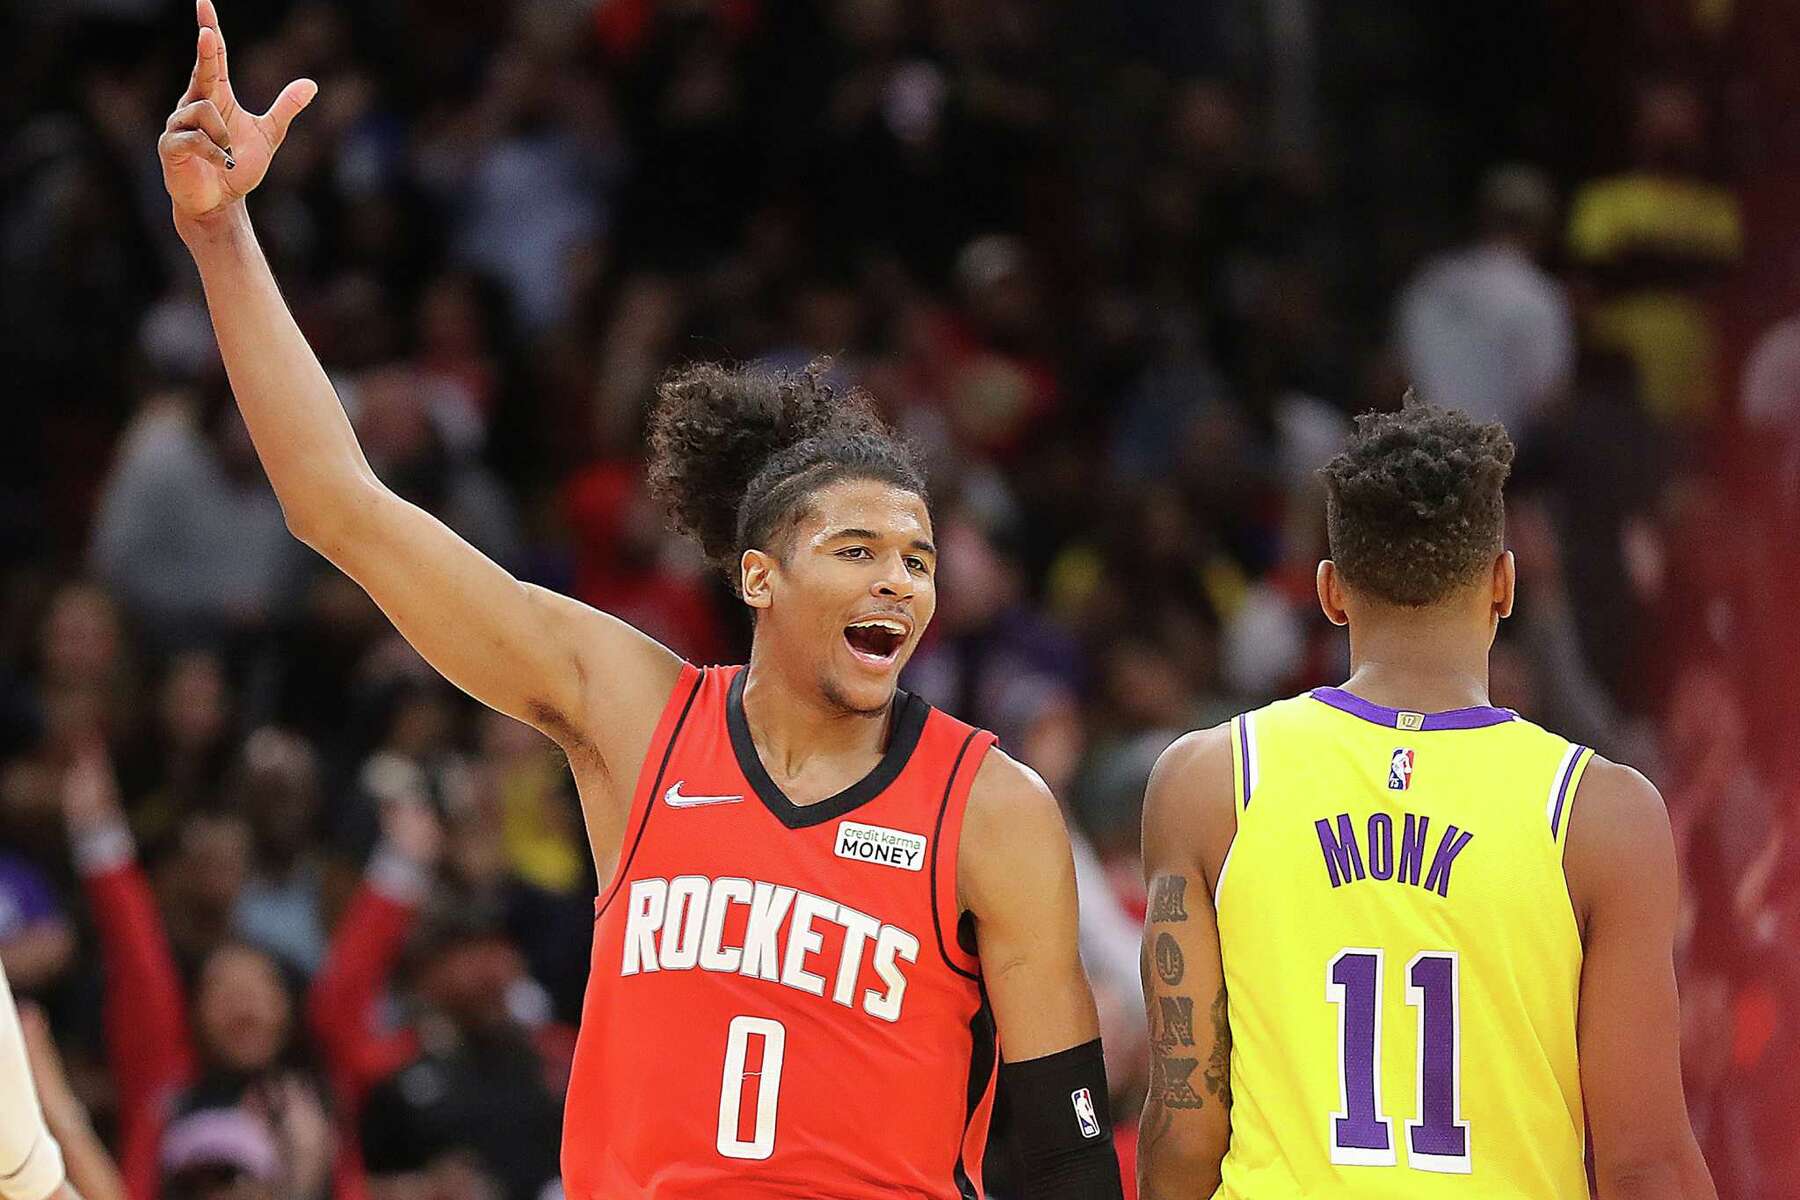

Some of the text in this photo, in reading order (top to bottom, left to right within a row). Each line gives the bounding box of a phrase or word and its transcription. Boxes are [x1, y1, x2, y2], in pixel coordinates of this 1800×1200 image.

[841, 838, 918, 867] MONEY
[844, 828, 921, 850] credit karma
[1314, 812, 1474, 898] MONK
[620, 875, 920, 1023] ROCKETS
[716, 1015, 787, 1161] 0
[1326, 947, 1472, 1174] 11
